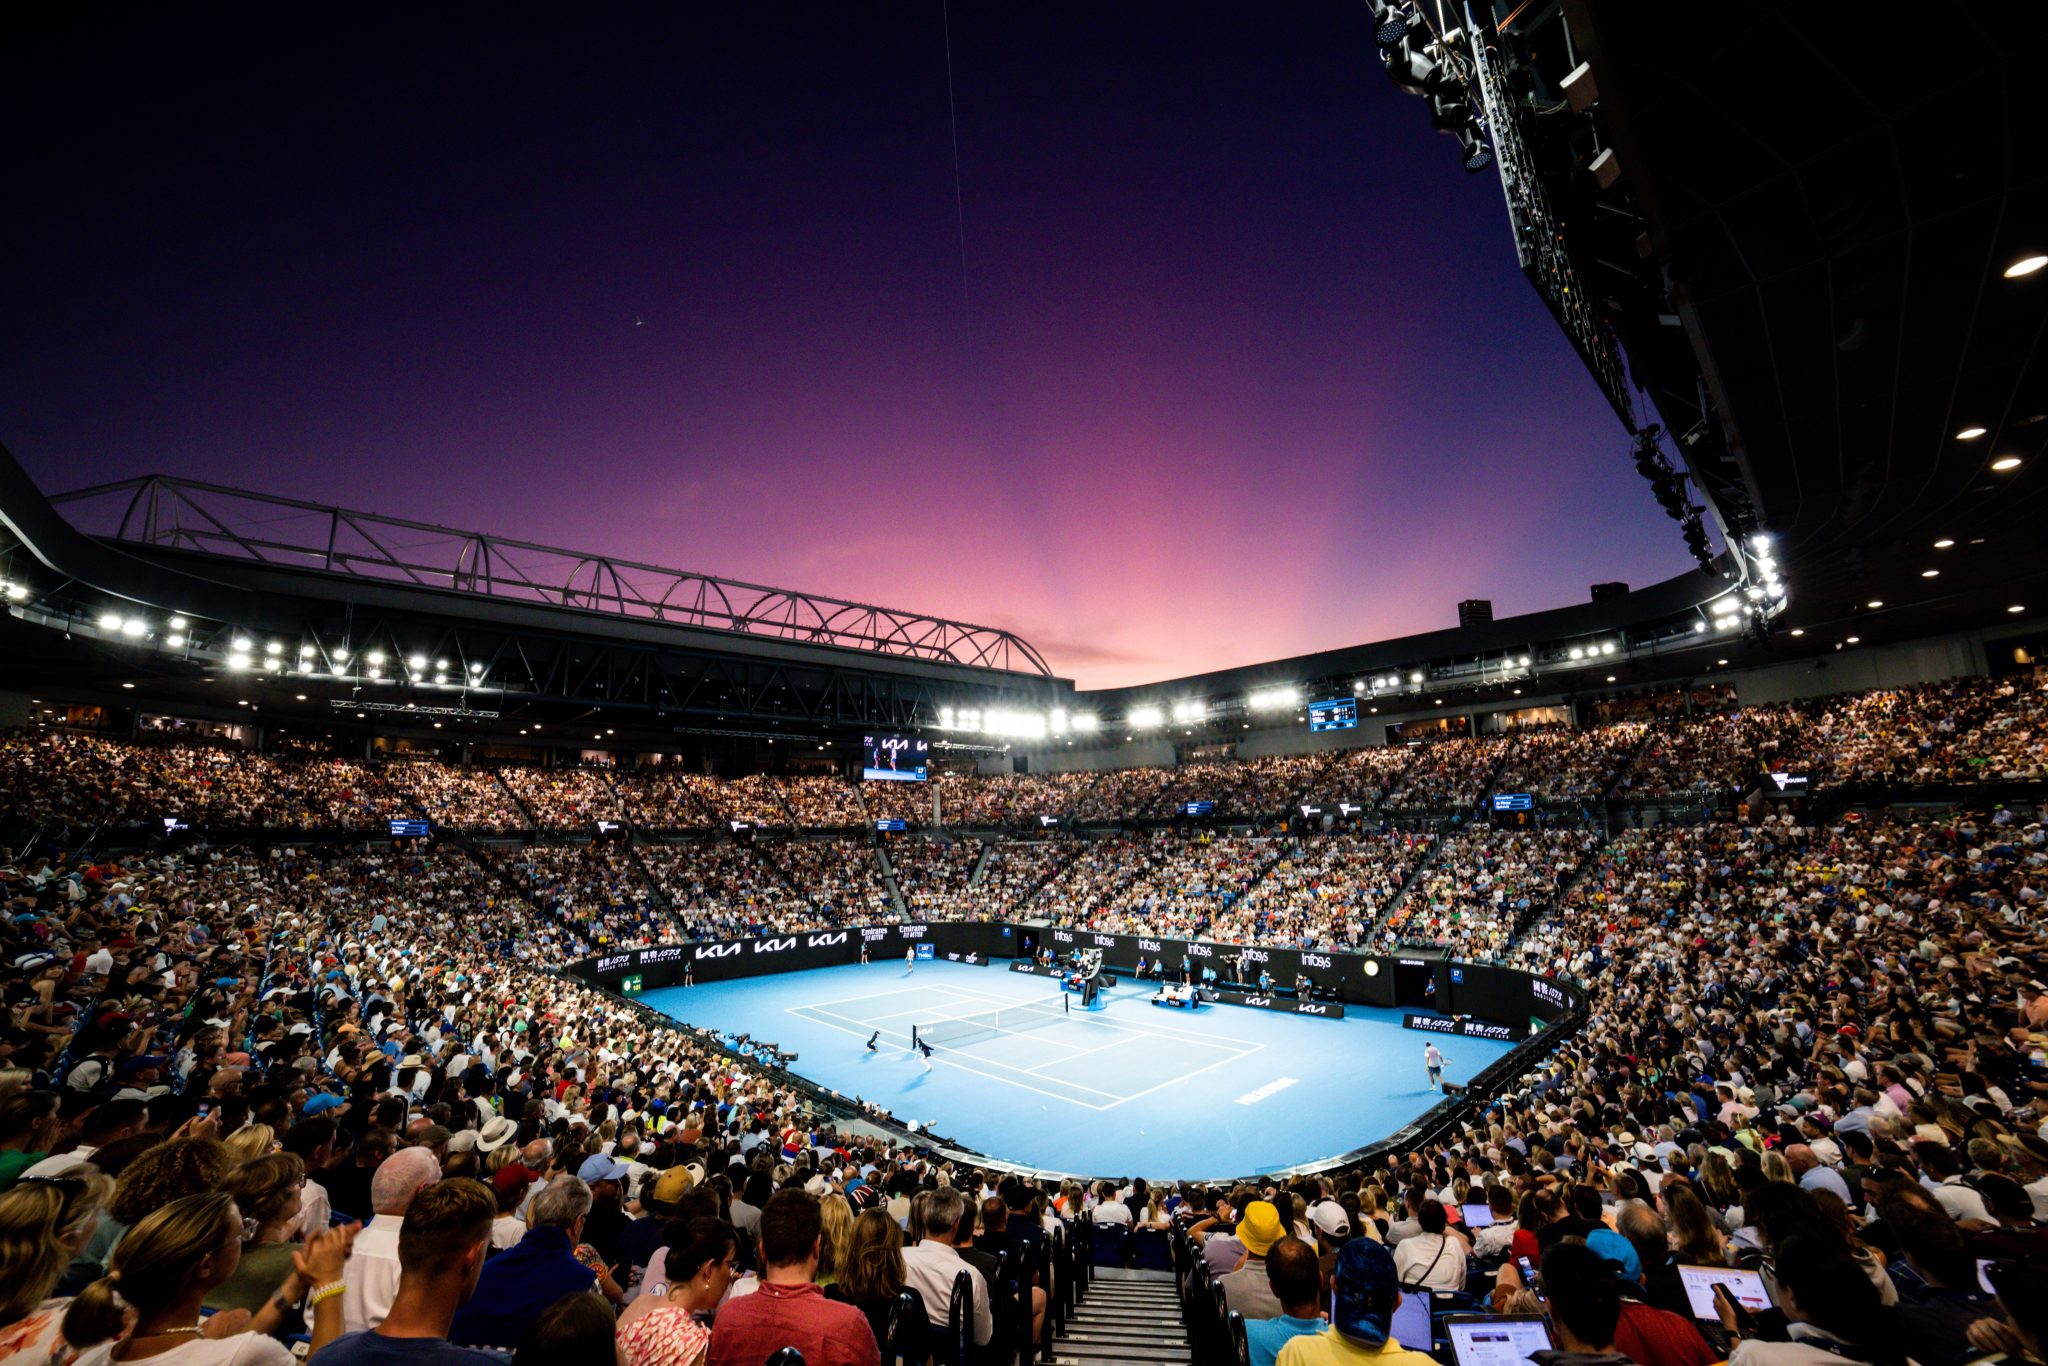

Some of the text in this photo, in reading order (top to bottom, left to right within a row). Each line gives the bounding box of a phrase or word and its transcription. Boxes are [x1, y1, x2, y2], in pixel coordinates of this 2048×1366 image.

[861, 928, 888, 936] Emirates
[899, 925, 927, 933] Emirates
[808, 932, 847, 947] KIA
[1055, 930, 1073, 943] Infosys
[1094, 934, 1115, 947] Infosys
[695, 942, 741, 959] KIA
[754, 937, 796, 953] KIA
[1138, 939, 1161, 952] Infosys
[1187, 943, 1212, 957] Infosys
[610, 954, 630, 964] 1573
[657, 948, 681, 957] 1573
[1241, 948, 1269, 963] Infosys
[1301, 953, 1331, 969] Infosys
[1548, 987, 1563, 1001] 1573
[1245, 997, 1270, 1006] KIA
[1299, 1003, 1326, 1013] KIA
[1430, 1019, 1454, 1028] 1573
[1484, 1026, 1509, 1035] 1573
